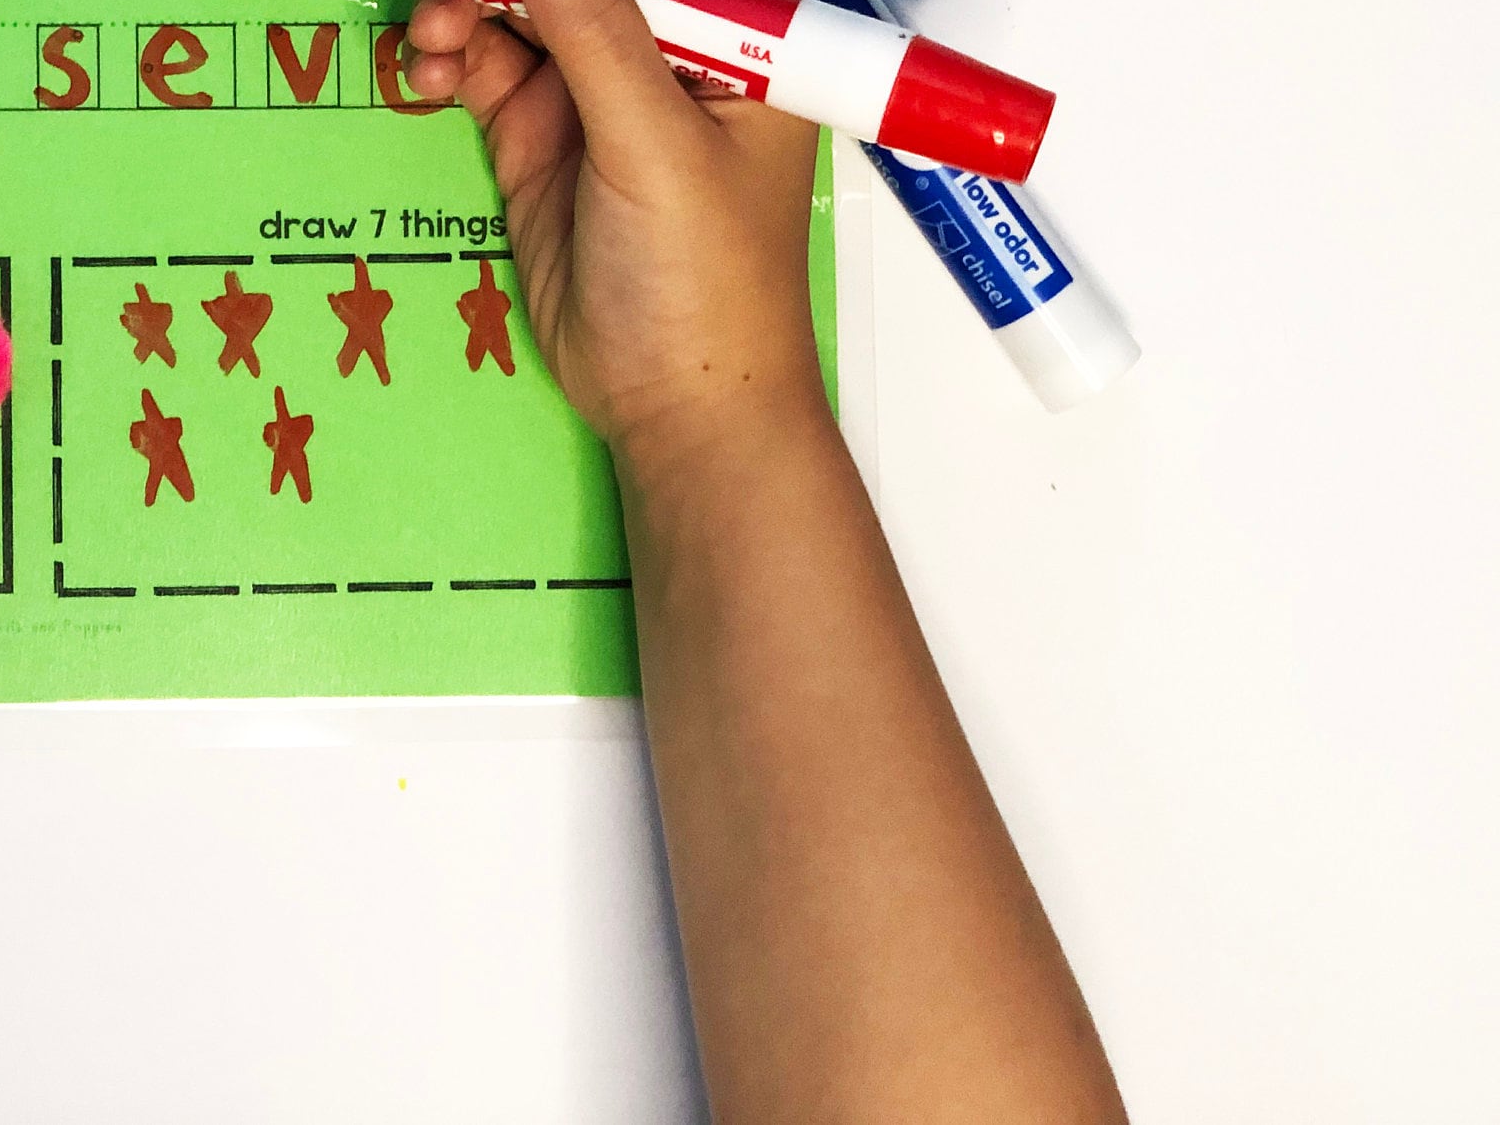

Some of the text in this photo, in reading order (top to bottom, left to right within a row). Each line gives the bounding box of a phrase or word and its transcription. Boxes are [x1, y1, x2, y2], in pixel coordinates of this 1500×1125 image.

[260, 209, 506, 244] draw 7 things
[962, 175, 1039, 272] low odor
[962, 254, 1012, 309] chisel
